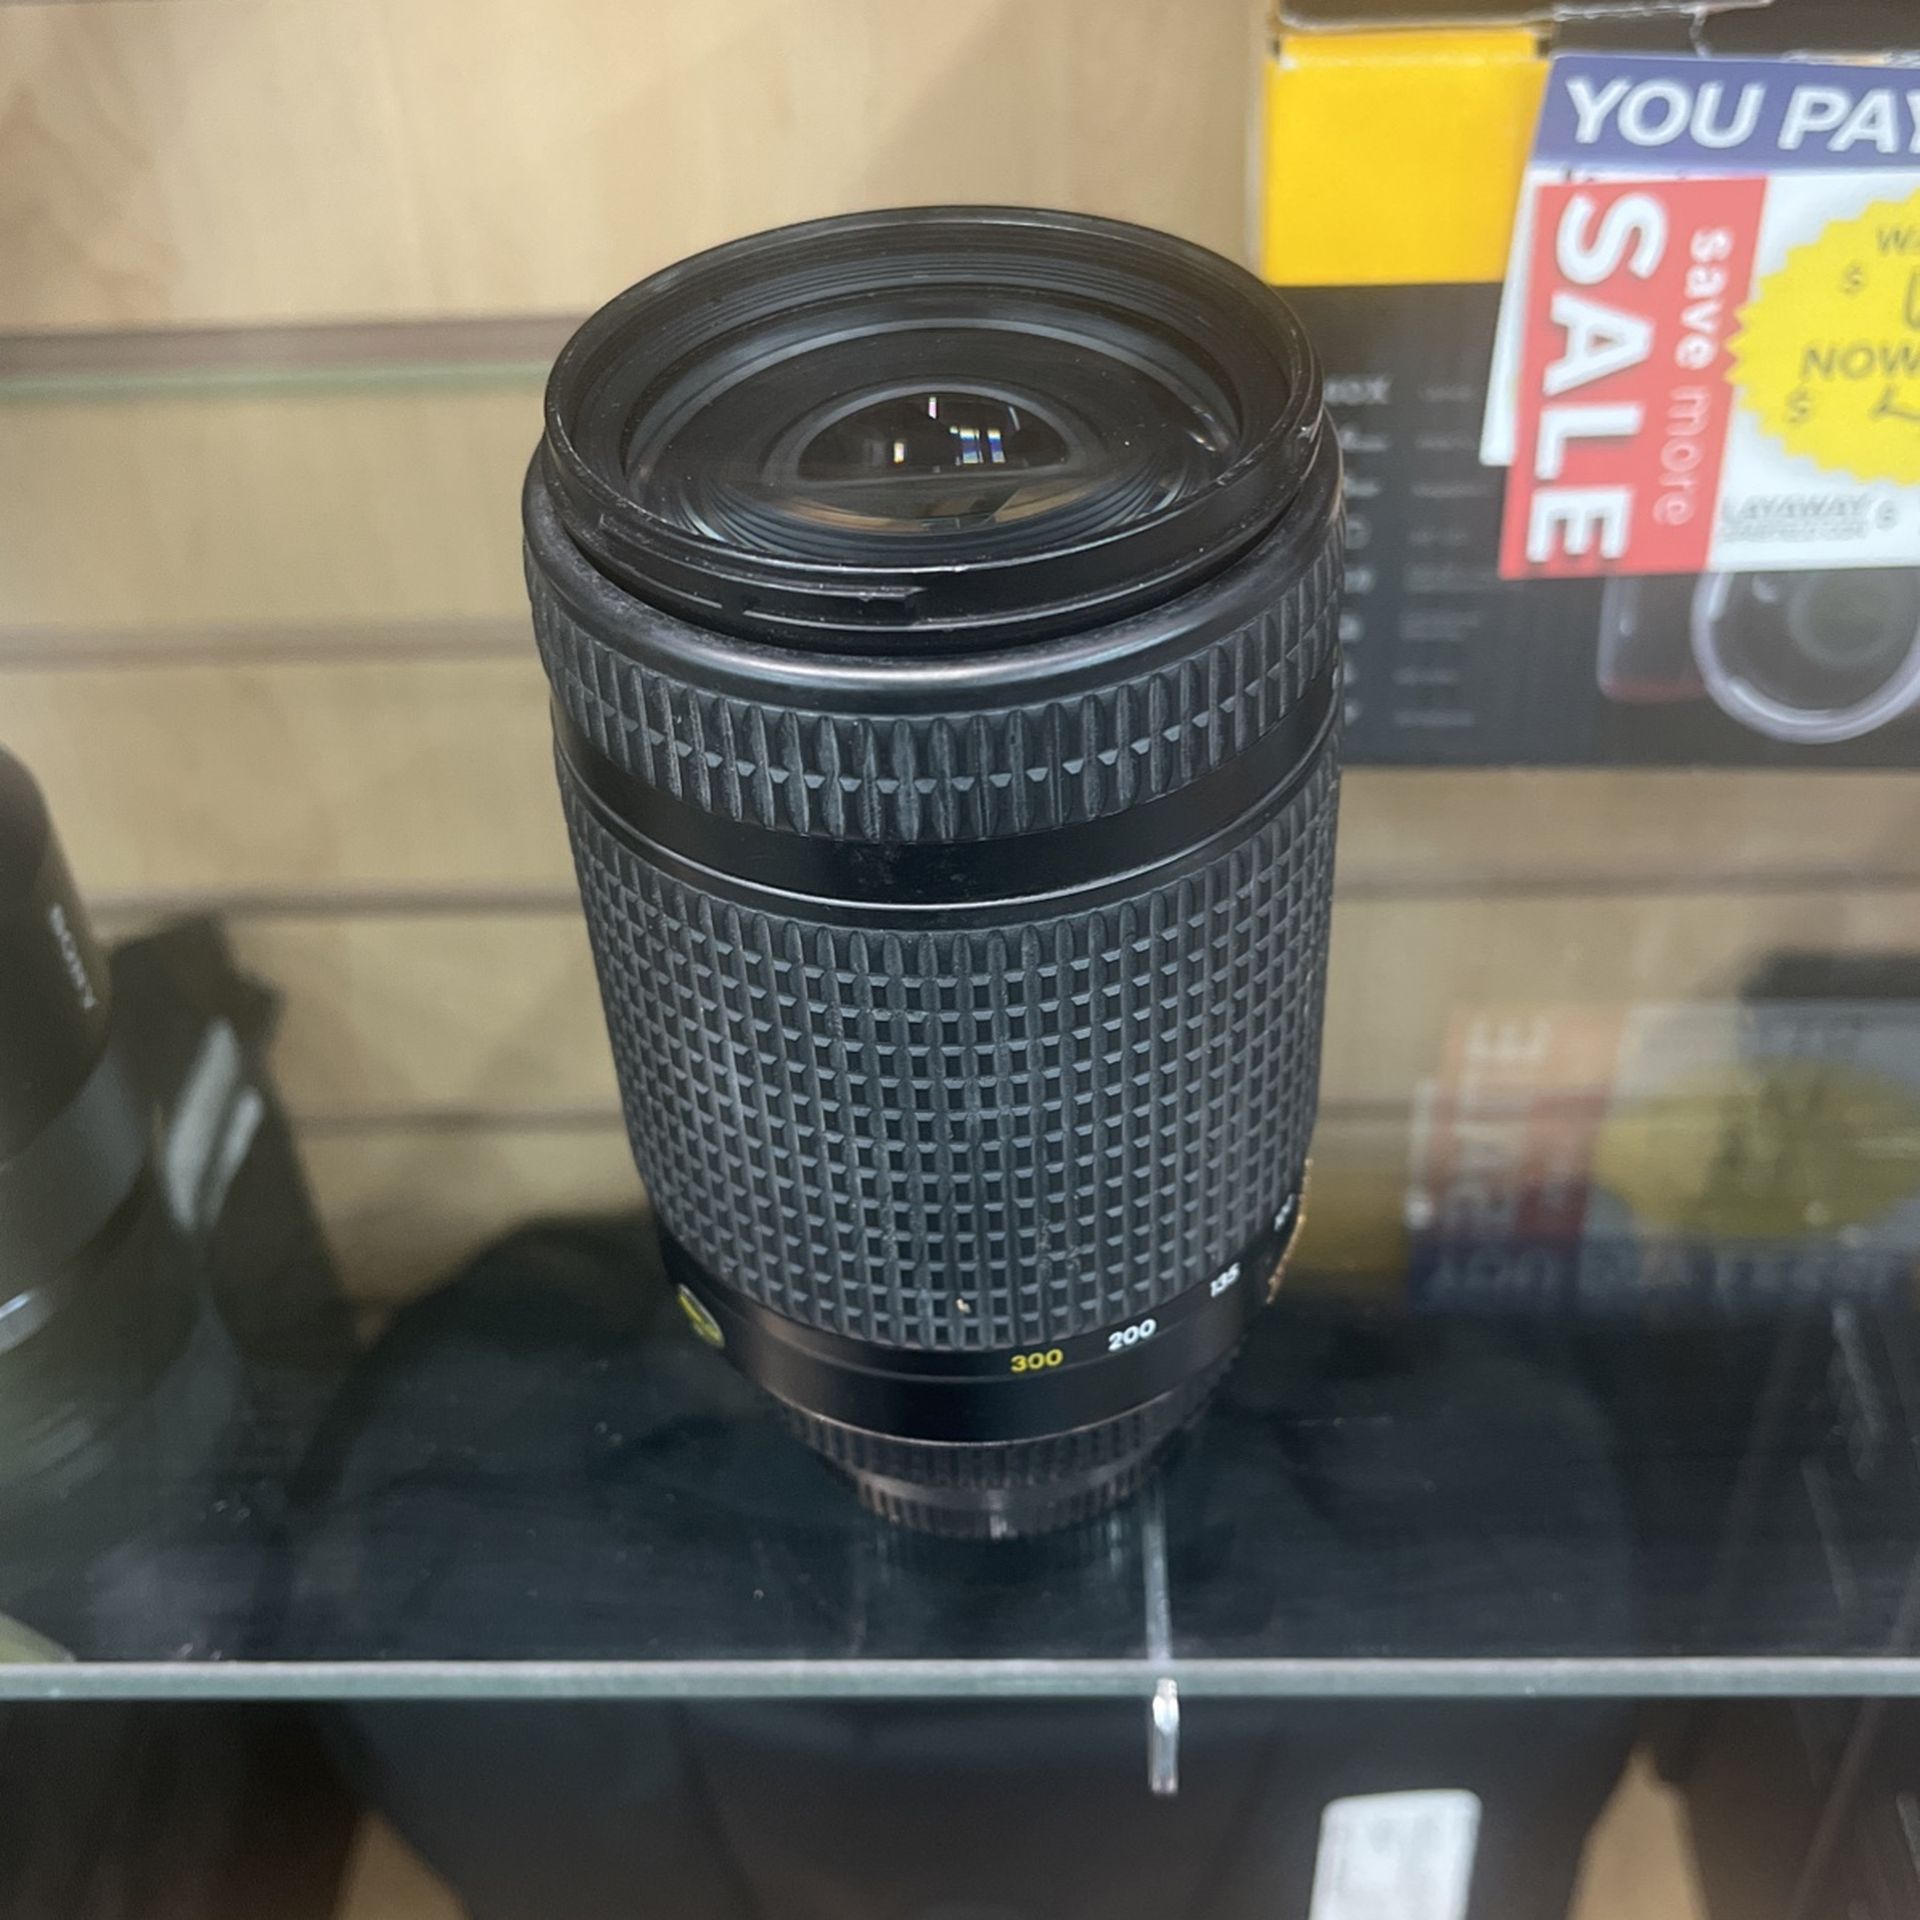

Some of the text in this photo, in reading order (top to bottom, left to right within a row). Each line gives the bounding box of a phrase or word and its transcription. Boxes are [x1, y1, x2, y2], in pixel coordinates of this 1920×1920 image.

[1566, 76, 1765, 149] YOU
[1524, 191, 1669, 564] SALE
[1652, 226, 1735, 526] save more
[1010, 1348, 1064, 1373] 300
[1108, 1318, 1157, 1351] 200
